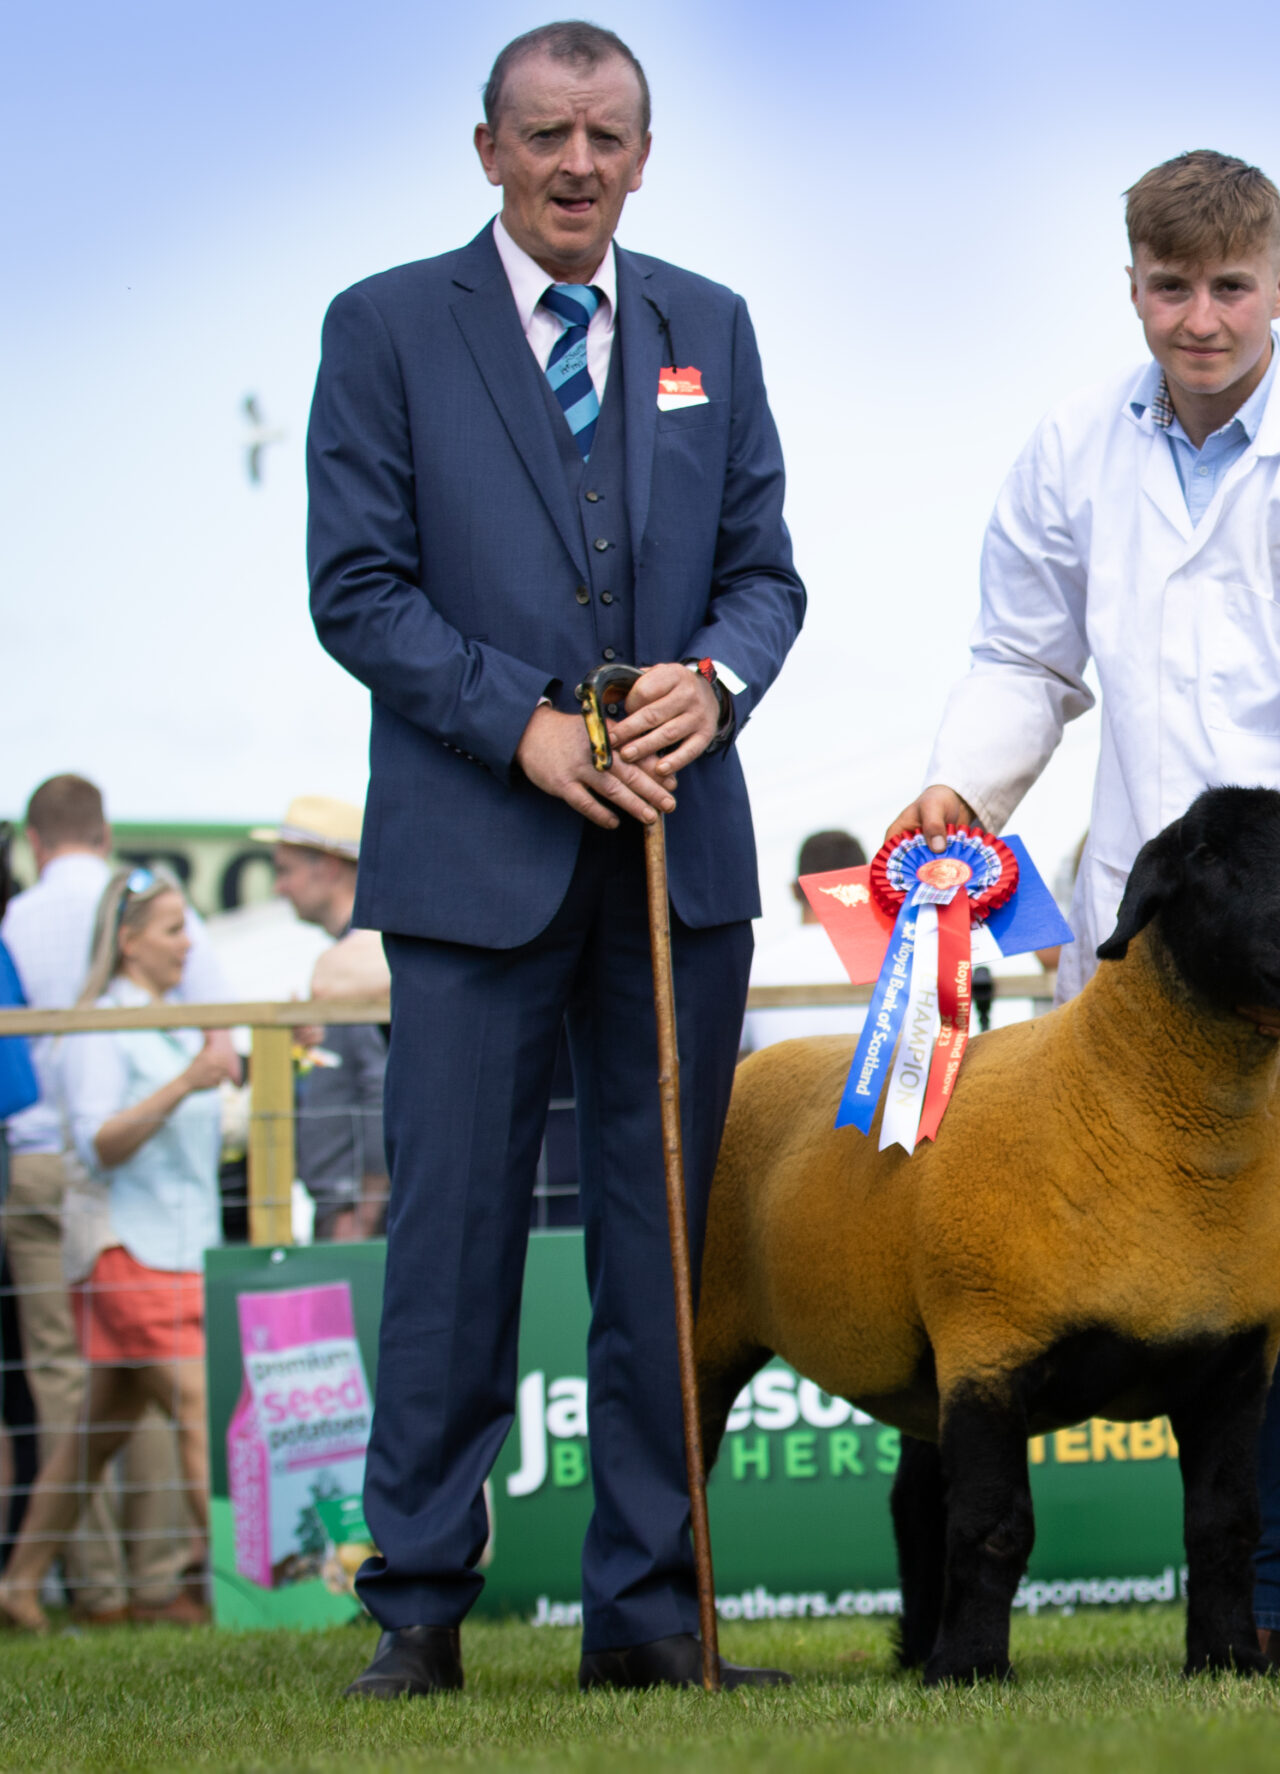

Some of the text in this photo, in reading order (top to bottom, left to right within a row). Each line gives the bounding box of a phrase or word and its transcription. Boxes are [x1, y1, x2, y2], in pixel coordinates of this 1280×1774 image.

[856, 942, 914, 1096] Royal Bank of Scotland
[938, 1015, 953, 1047] 2023
[942, 960, 970, 1095] Royal Highland Show
[263, 1368, 364, 1424] seed
[269, 1414, 368, 1450] potatoes
